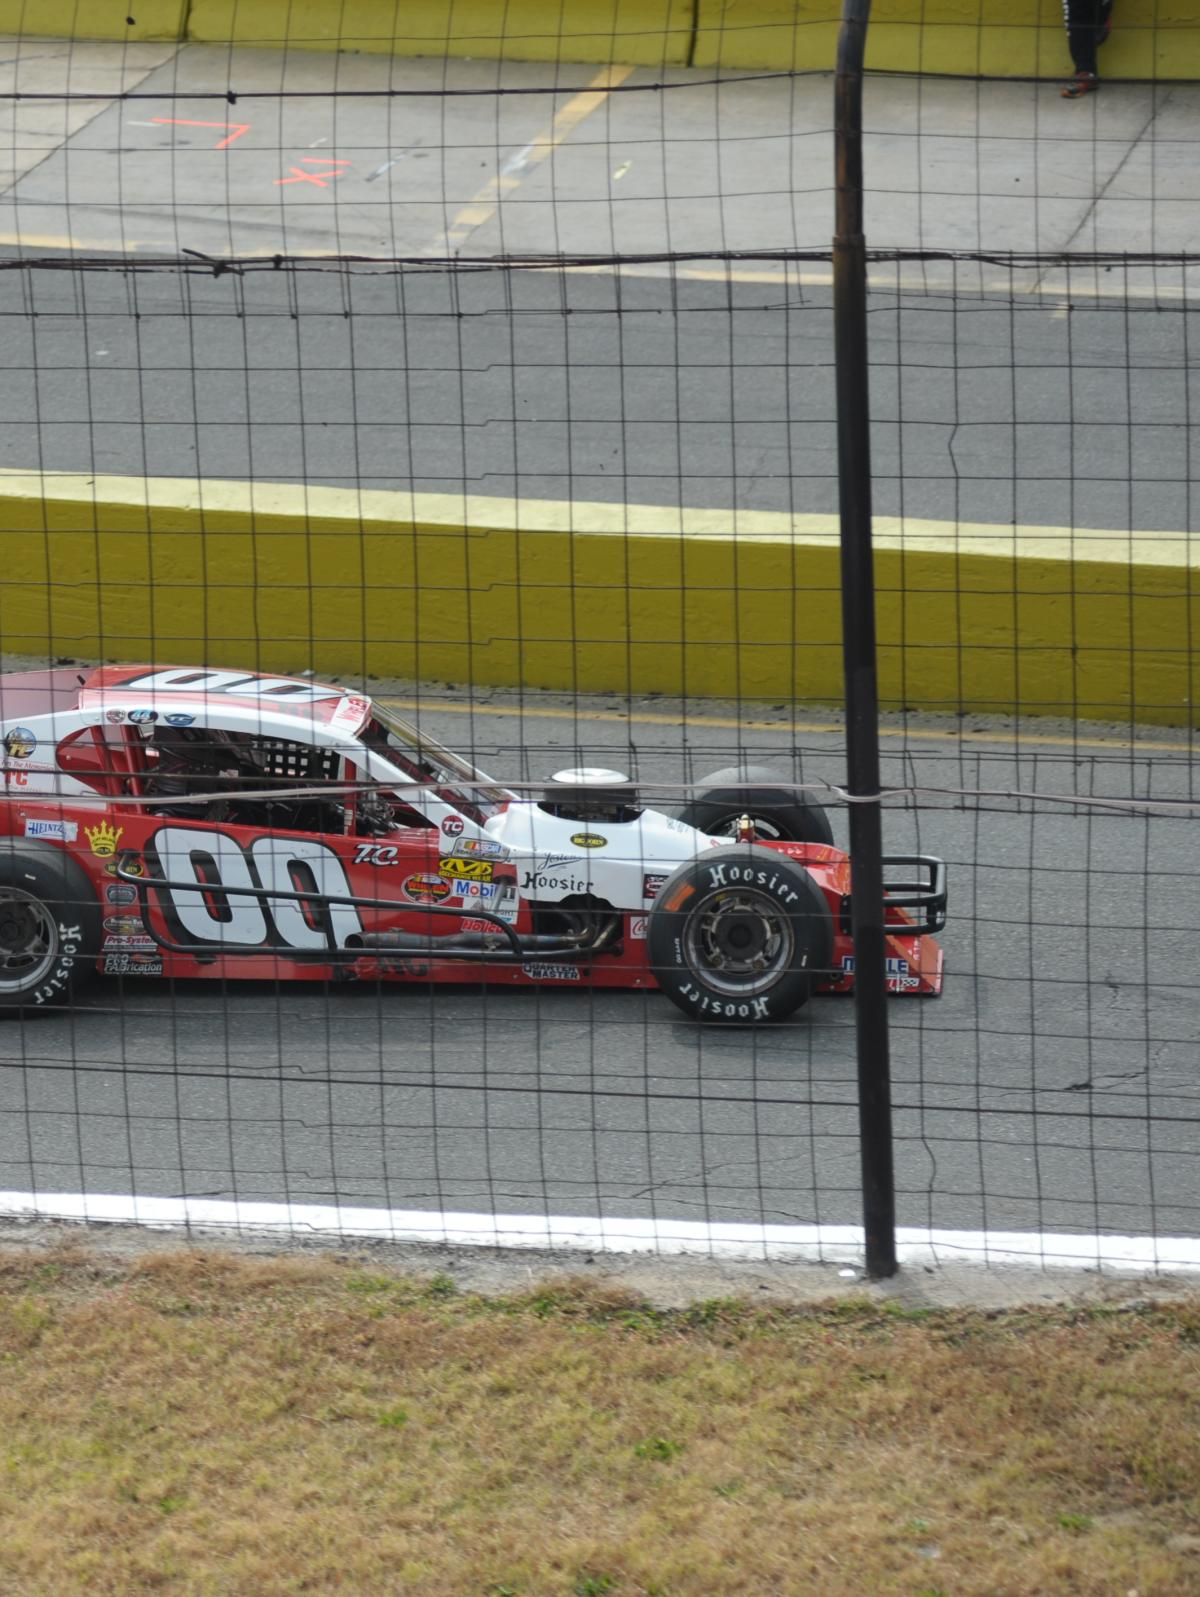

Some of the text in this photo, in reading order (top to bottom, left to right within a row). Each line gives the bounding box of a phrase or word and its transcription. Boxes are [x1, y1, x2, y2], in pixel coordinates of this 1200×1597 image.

[443, 820, 463, 832] TC
[148, 826, 365, 951] 00
[521, 871, 595, 892] Hoosier
[709, 863, 799, 903] Hoosier
[35, 923, 82, 1004] Hoosier
[680, 983, 770, 1020] Hoosier
